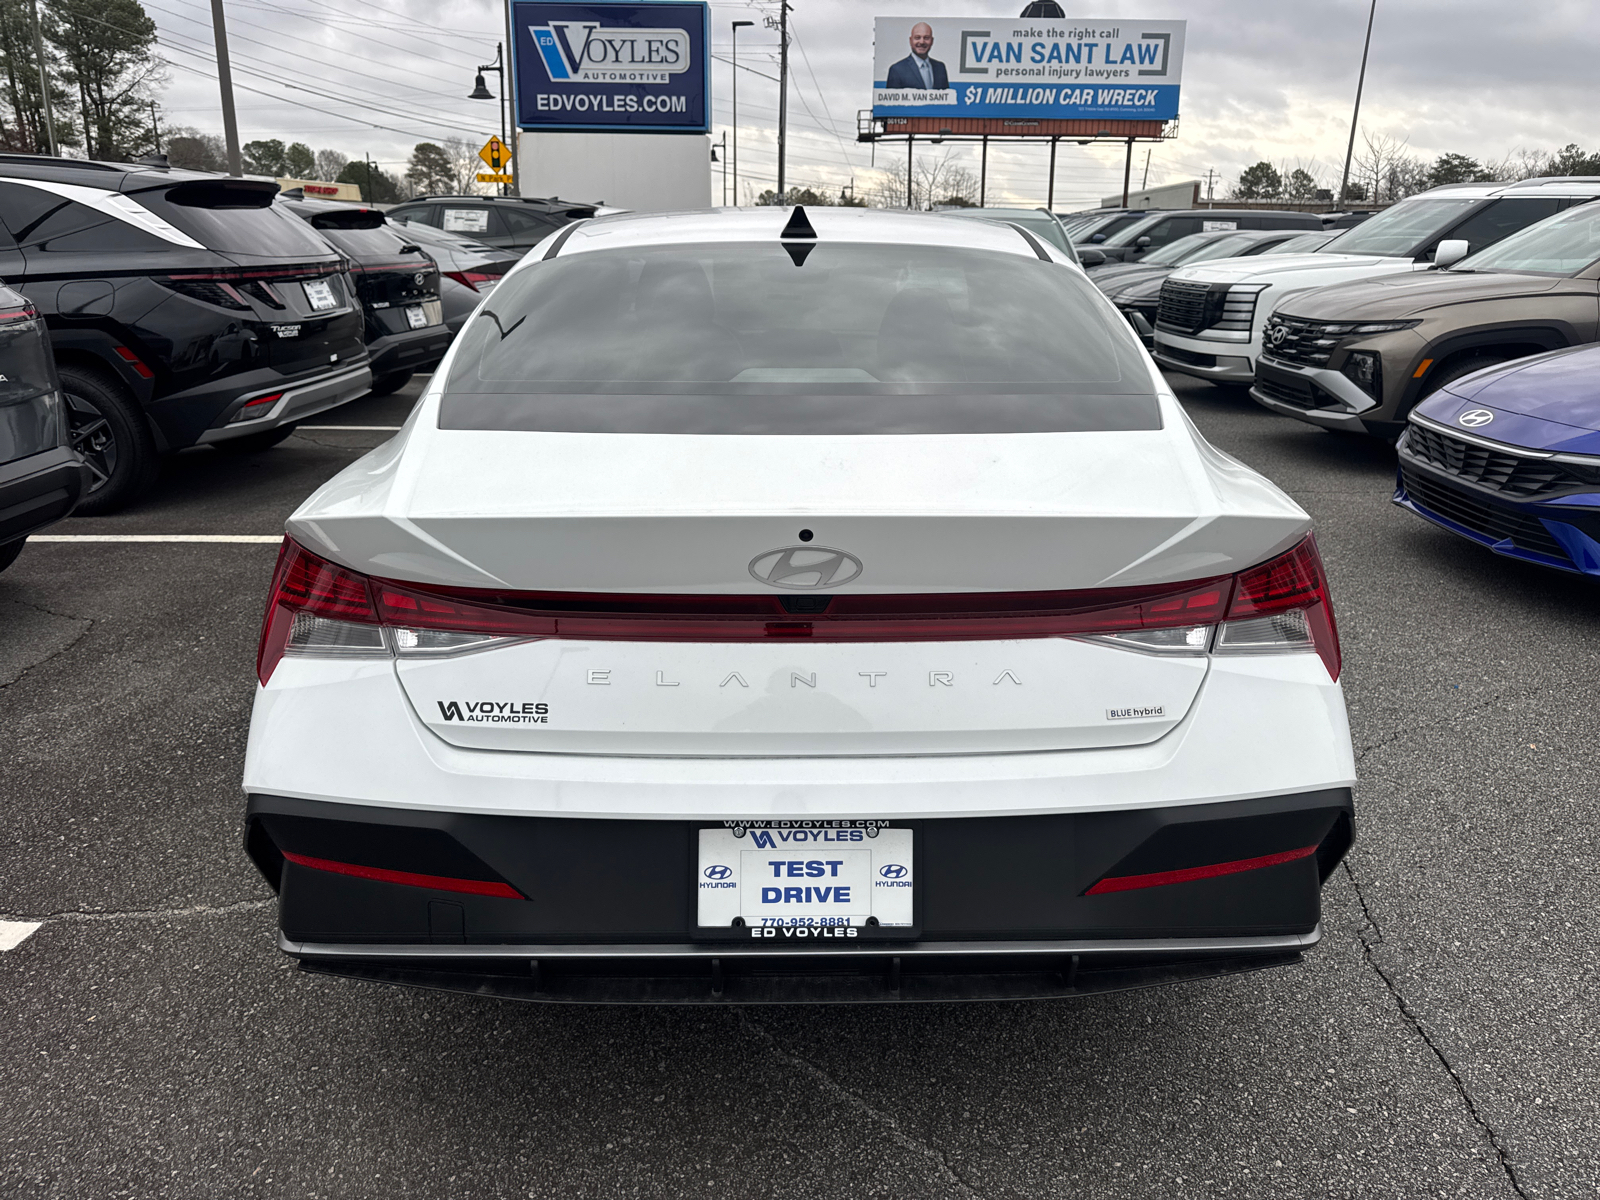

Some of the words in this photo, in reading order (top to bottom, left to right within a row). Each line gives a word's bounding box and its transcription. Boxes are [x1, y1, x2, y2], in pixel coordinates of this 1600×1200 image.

[1012, 27, 1043, 38] make
[1046, 27, 1065, 38] the
[1068, 27, 1096, 40] right
[1099, 28, 1119, 39] call
[540, 37, 553, 46] ED
[552, 24, 680, 74] VOYLES
[971, 41, 1023, 63] VAN
[1030, 42, 1099, 64] SANT
[1105, 43, 1159, 65] LAW
[583, 72, 667, 81] AUTOMOTIVE
[996, 65, 1045, 78] personal
[1048, 66, 1082, 79] injury
[1084, 66, 1130, 80] lawyers
[878, 93, 900, 101] DAVID
[901, 93, 910, 101] M.
[912, 93, 928, 101] VAN
[929, 93, 949, 102] SANT
[964, 85, 983, 105] $1
[985, 87, 1057, 105] MILLION
[1059, 88, 1094, 105] CAR
[1097, 88, 1159, 106] WRECK
[537, 94, 686, 112] EDVOYLES.COM
[586, 668, 1022, 689] ELANTRA
[465, 702, 549, 714] VOYLES
[1110, 709, 1132, 717] BLUE
[1133, 706, 1163, 716] hybrid
[466, 714, 548, 723] AUTOMOTIVE
[723, 820, 890, 828] WWW.EDVOYLES.COM
[778, 830, 863, 842] VOYLES
[768, 860, 843, 877] TEST
[875, 880, 912, 888] HYUNDAI
[761, 886, 851, 903] DRIVE
[761, 917, 851, 927] 770-952-8881
[751, 927, 776, 937] ED
[783, 927, 858, 937] VOYLES
